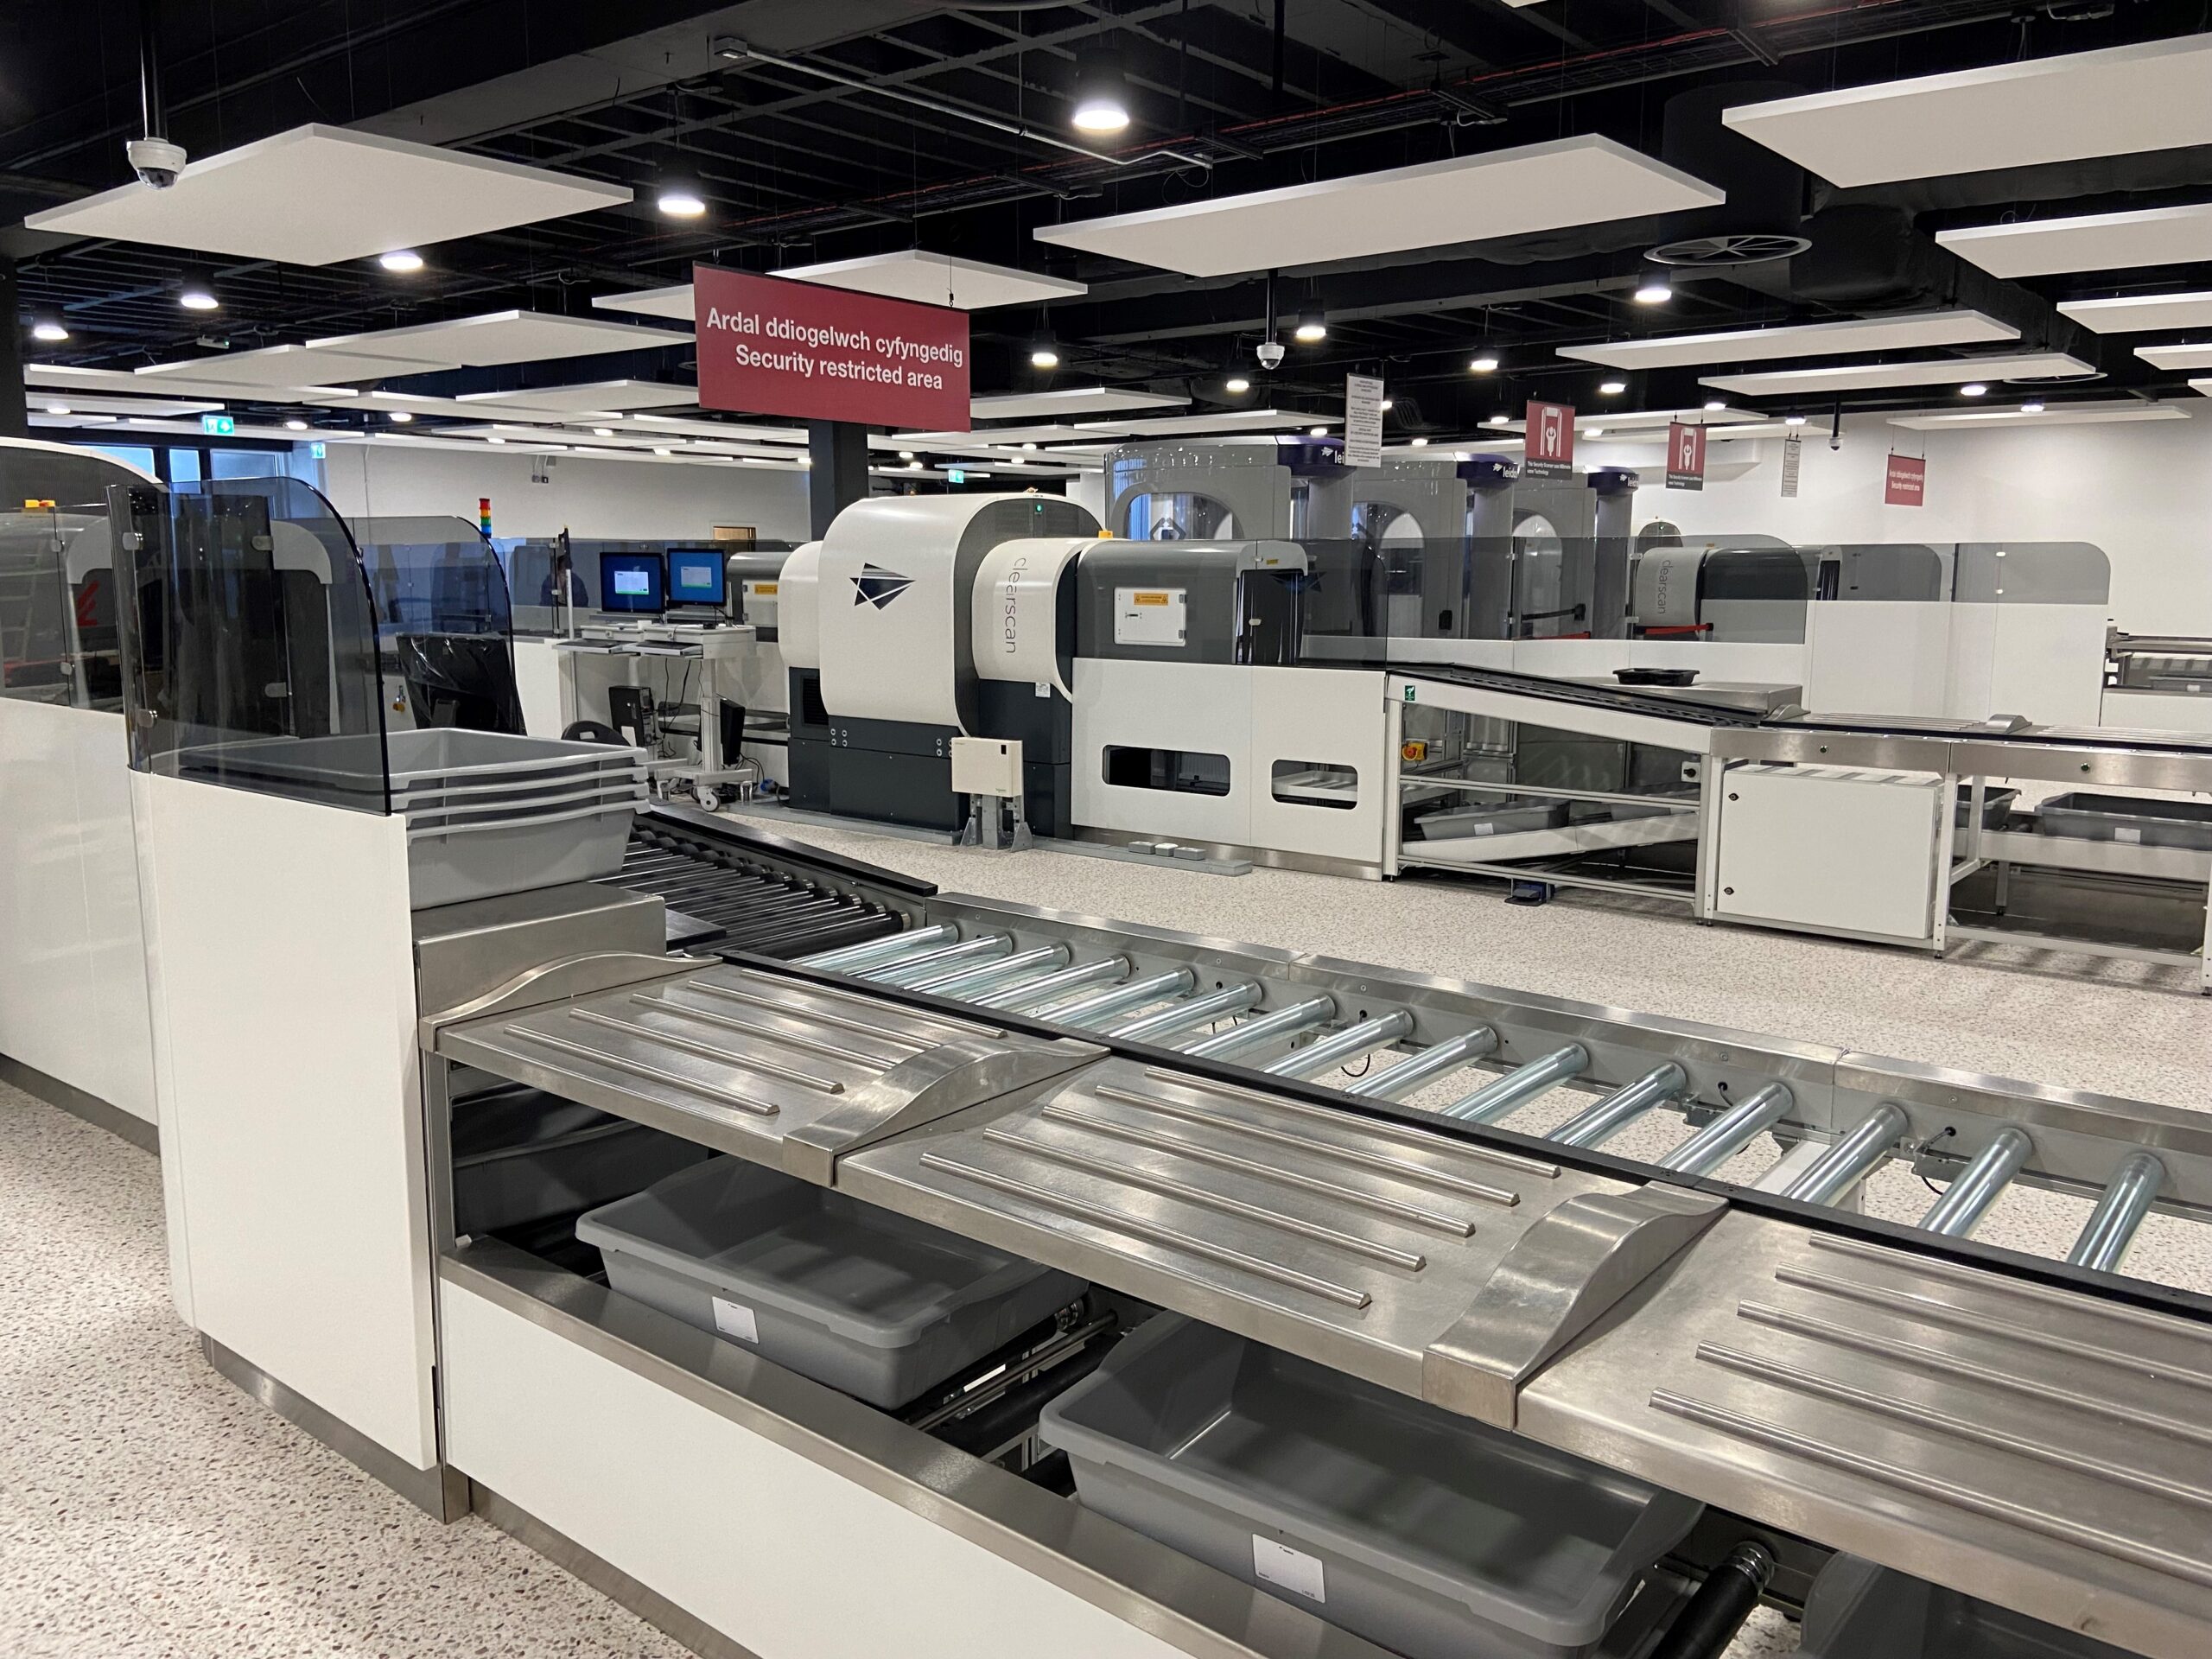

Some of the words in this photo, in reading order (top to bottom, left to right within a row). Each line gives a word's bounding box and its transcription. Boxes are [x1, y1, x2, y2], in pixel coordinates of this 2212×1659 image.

[707, 308, 760, 335] Ardal
[766, 317, 870, 351] ddiogelwch
[875, 336, 963, 368] cyfyngedig
[735, 344, 814, 378] Security
[820, 359, 902, 385] restricted
[907, 372, 943, 390] area
[1334, 449, 1344, 464] lei
[1005, 557, 1028, 653] clearscan
[1657, 560, 1673, 614] clearscan
